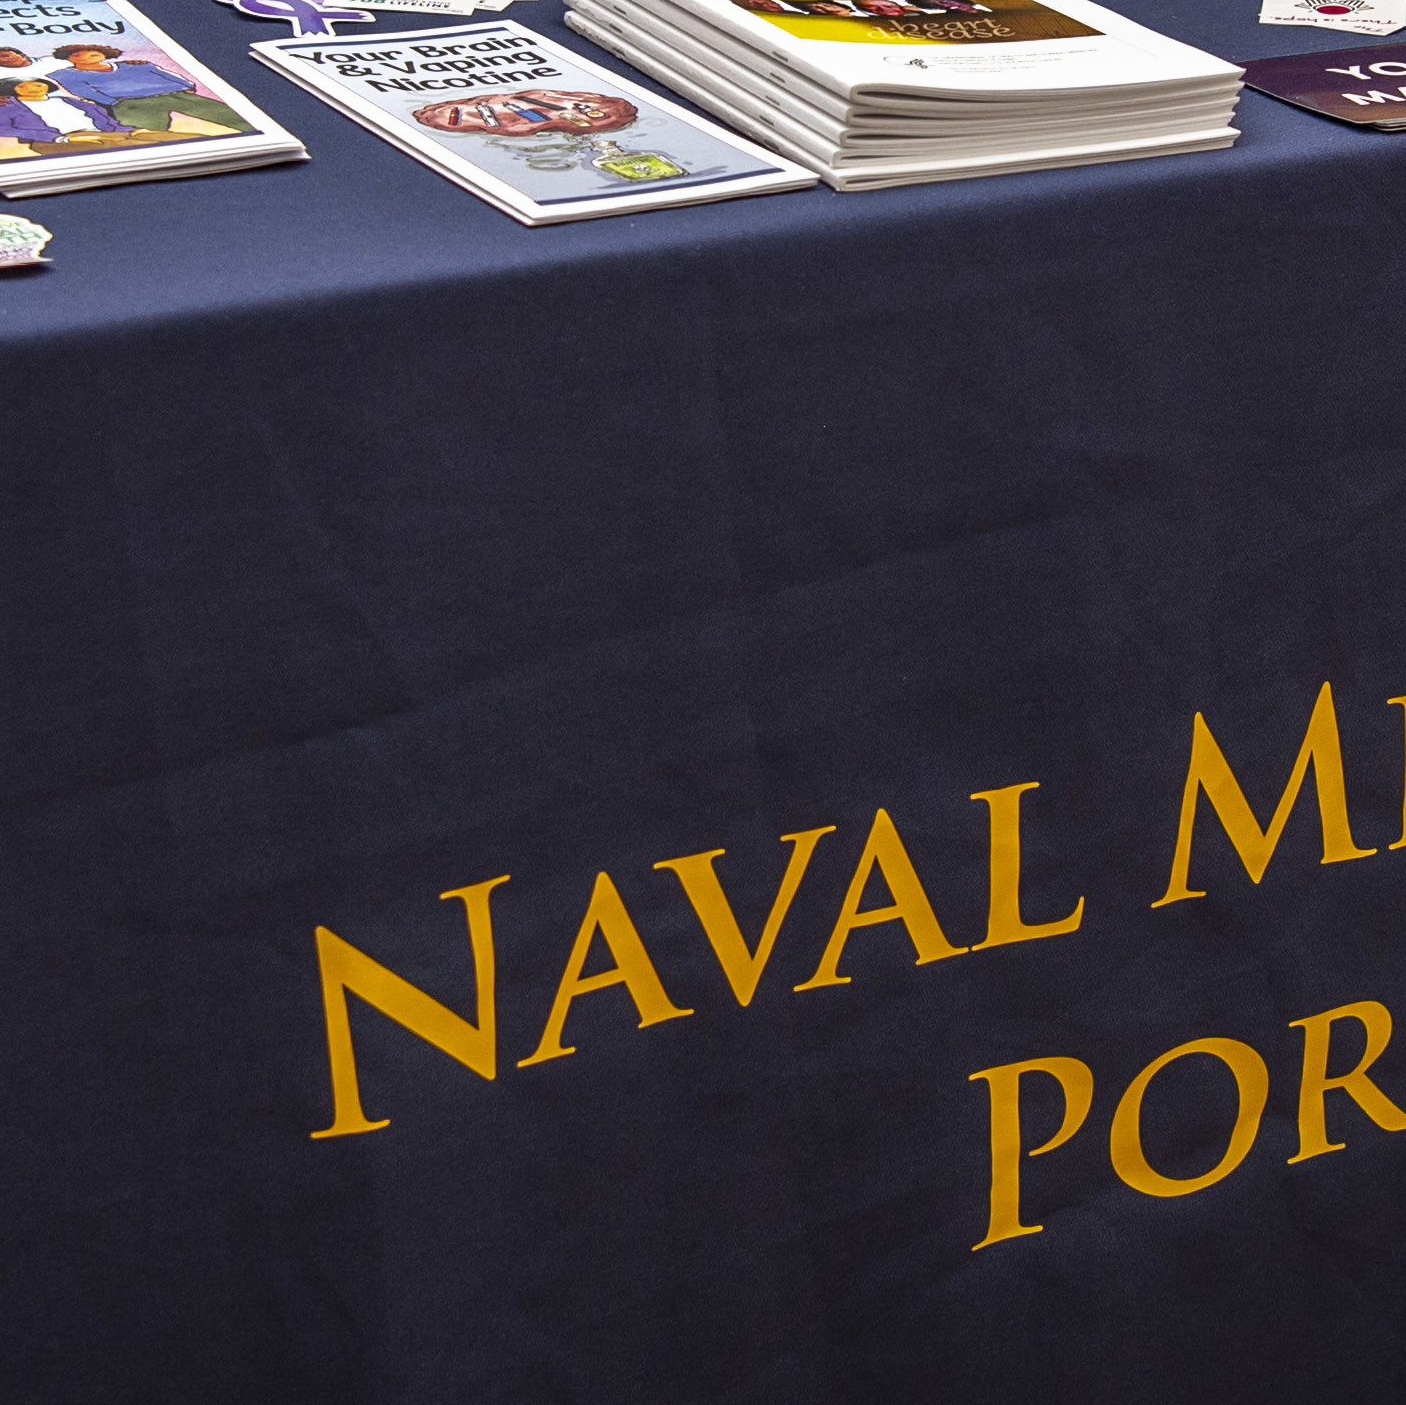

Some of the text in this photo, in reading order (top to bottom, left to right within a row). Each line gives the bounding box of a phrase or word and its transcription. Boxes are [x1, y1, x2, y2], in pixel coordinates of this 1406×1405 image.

[390, 0, 452, 10] LIFELINE
[9, 16, 129, 41] Body
[865, 25, 1017, 41] disease
[888, 17, 1001, 34] heart
[289, 33, 540, 67] Your Brain
[337, 50, 548, 78] & Vaping
[365, 63, 566, 94] Nicotine
[309, 781, 1085, 1140] NAVAL
